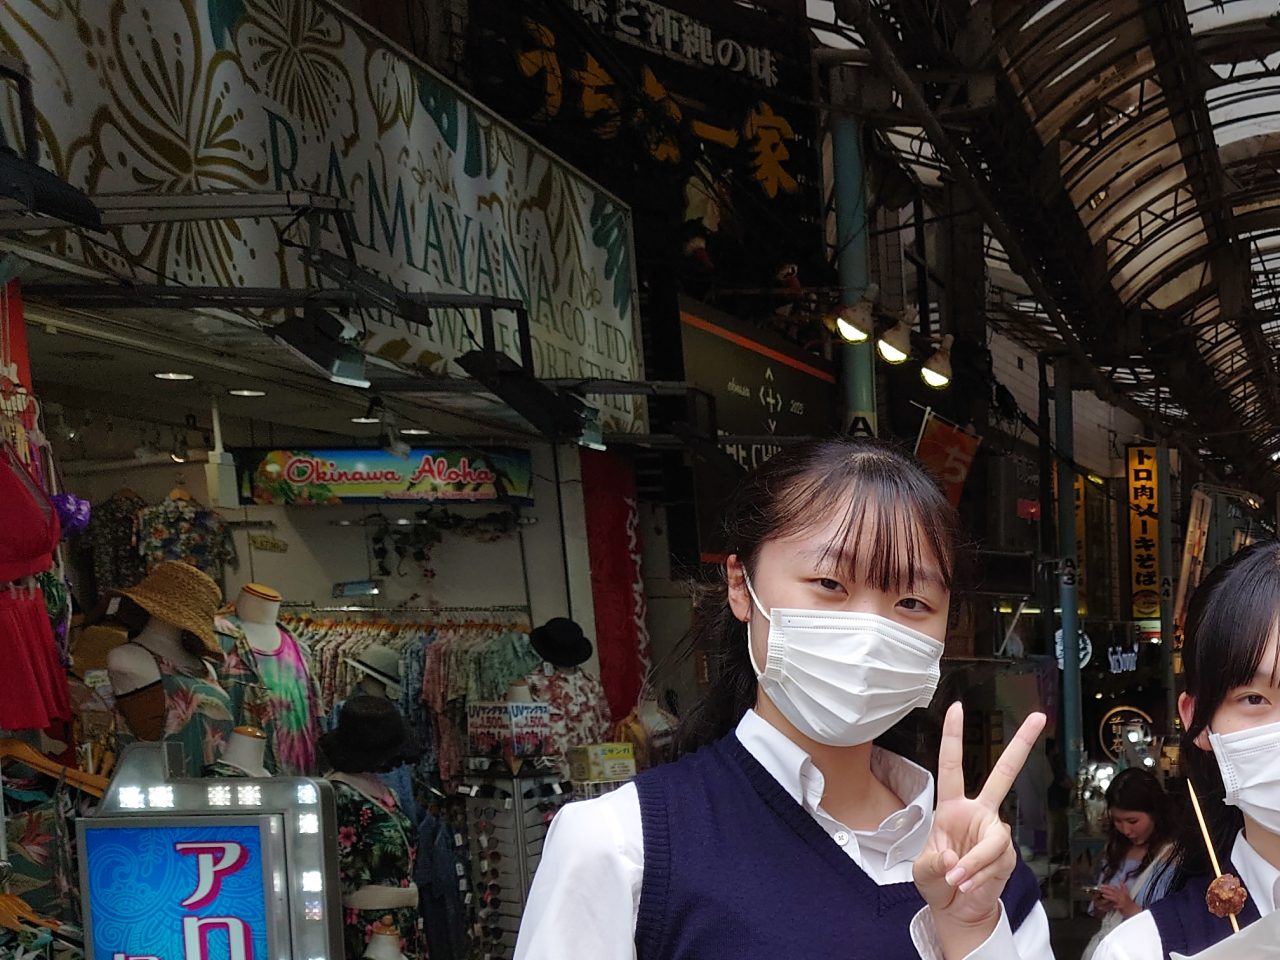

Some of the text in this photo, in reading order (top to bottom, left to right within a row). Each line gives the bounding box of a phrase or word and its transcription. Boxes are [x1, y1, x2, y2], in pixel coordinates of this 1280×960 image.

[263, 107, 562, 333] RAMAYANA
[285, 454, 496, 484] Okinawa Aloha
[1133, 450, 1157, 586] トロ肉ソーキそば
